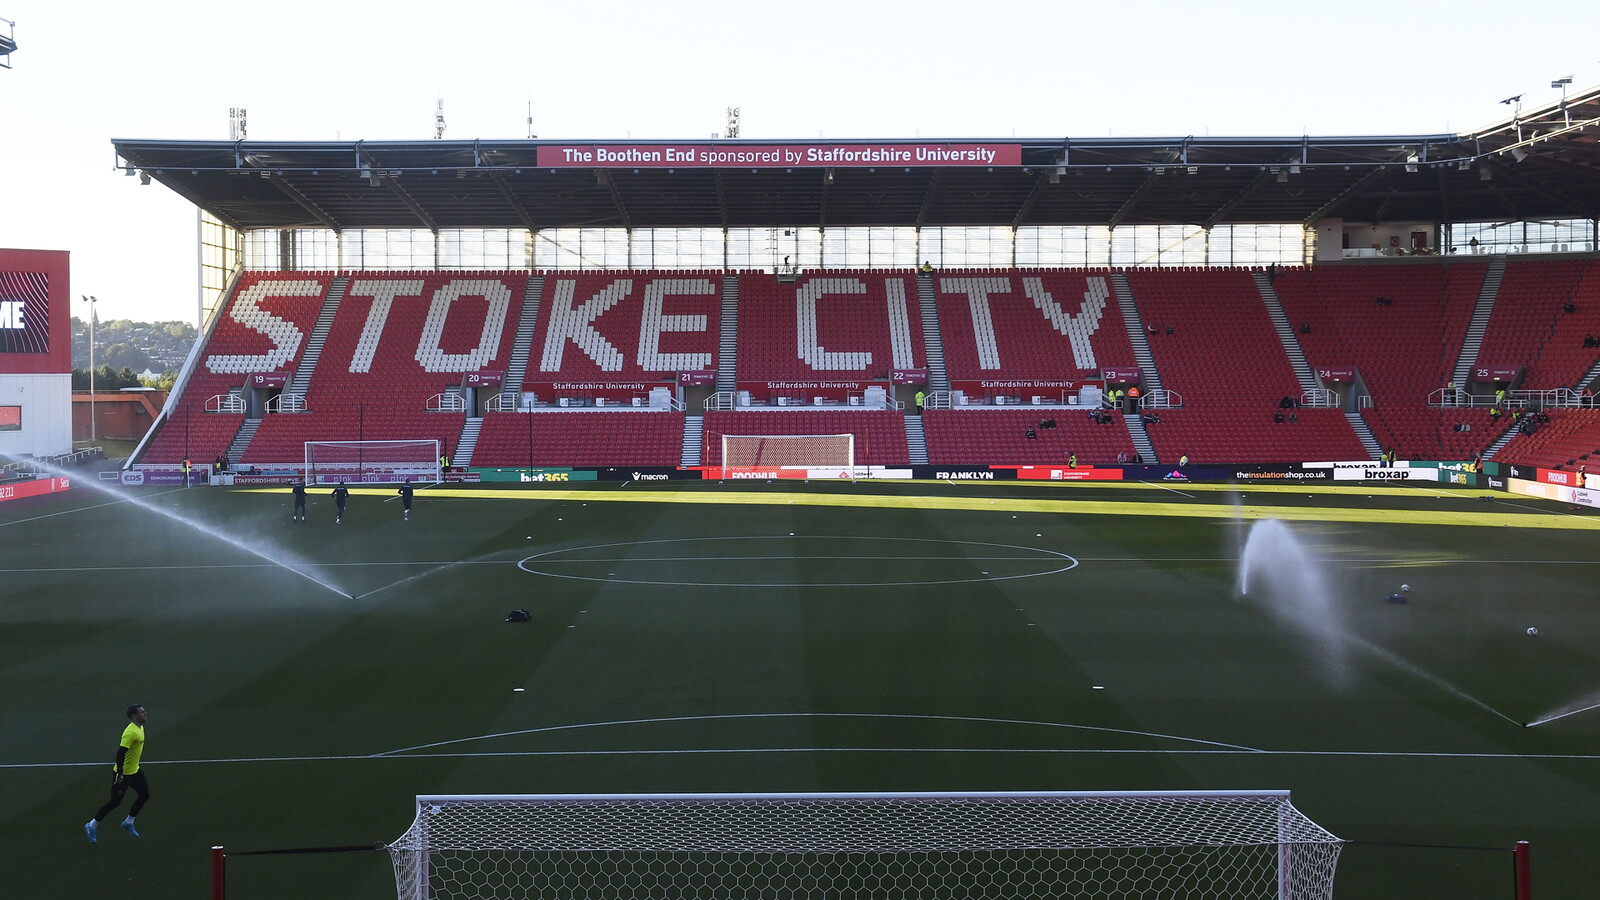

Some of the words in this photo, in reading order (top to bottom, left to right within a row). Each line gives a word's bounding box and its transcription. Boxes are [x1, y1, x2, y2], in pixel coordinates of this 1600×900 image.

[562, 148, 593, 162] The
[596, 148, 661, 162] Boothen
[665, 148, 695, 162] End
[699, 148, 780, 165] sponsored
[785, 148, 803, 165] by
[806, 147, 912, 162] Staffordshire
[915, 147, 996, 164] University
[206, 279, 716, 374] STOKE
[796, 277, 1109, 370] CITY
[893, 372, 904, 380] 22
[1105, 371, 1116, 379] 23
[1319, 370, 1331, 378] 24
[1477, 368, 1488, 377] 25
[254, 375, 264, 383] 19
[468, 374, 480, 382] 20
[681, 373, 691, 381] 21
[553, 382, 604, 390] Staffordshire
[605, 382, 645, 391] University
[767, 381, 818, 389] Staffordshire
[820, 381, 860, 390] University
[981, 380, 1032, 388] Staffordshire
[1033, 380, 1074, 389] University
[361, 474, 381, 482] pink
[641, 473, 669, 481] macron
[936, 472, 994, 480] FRANKLYN
[1236, 471, 1326, 479] theinsulationshop.co.uk
[1364, 469, 1409, 479] broxap
[333, 475, 353, 483] pink
